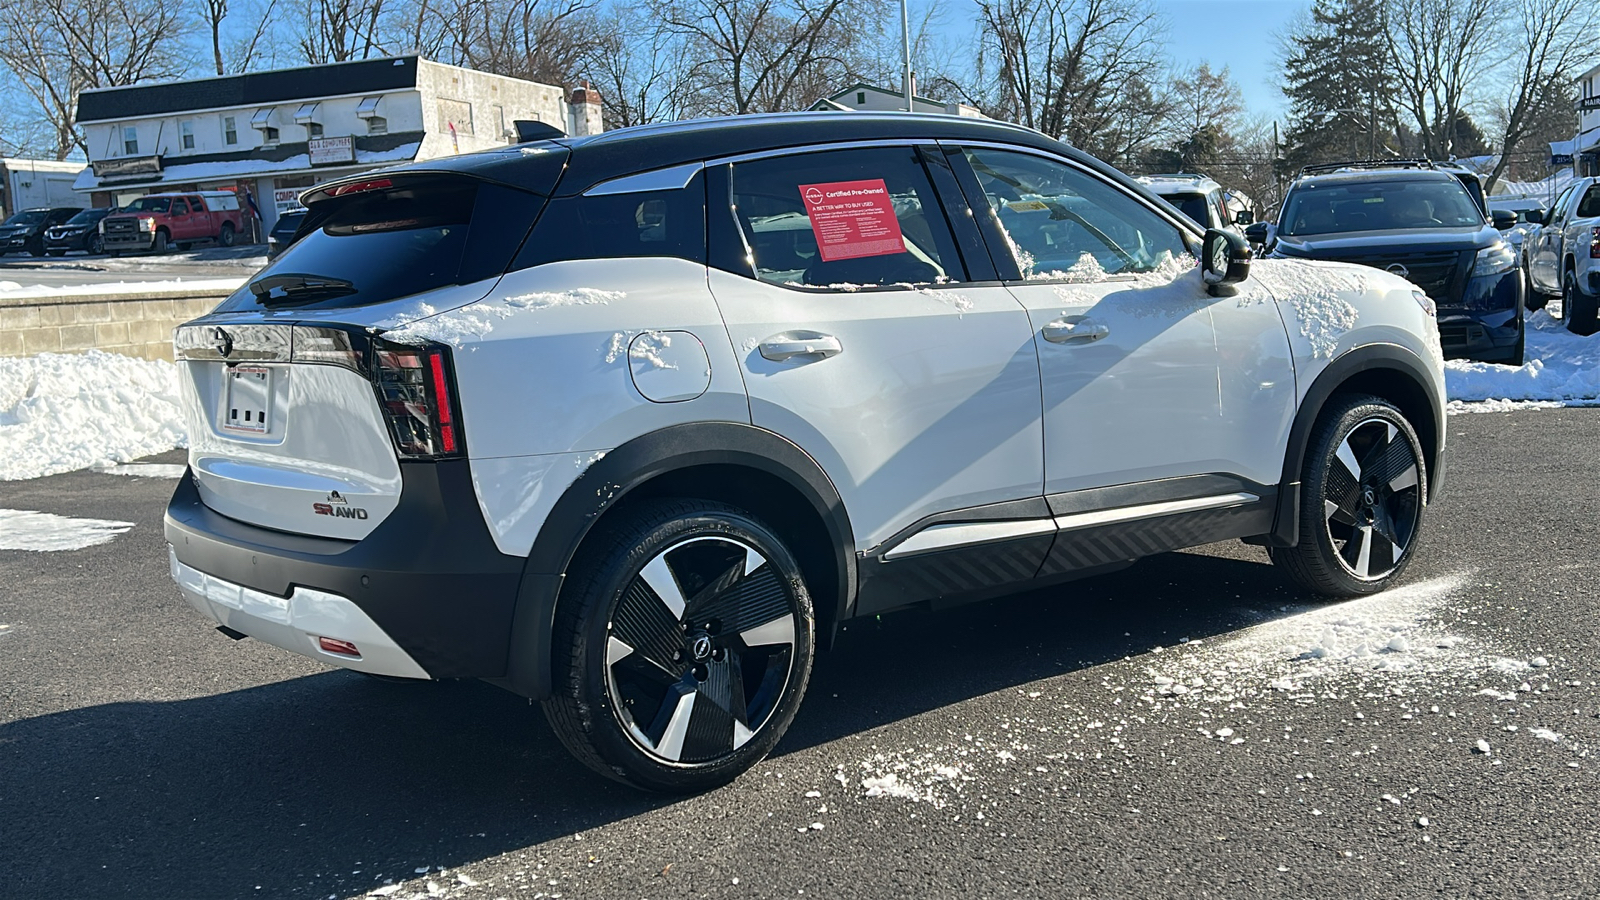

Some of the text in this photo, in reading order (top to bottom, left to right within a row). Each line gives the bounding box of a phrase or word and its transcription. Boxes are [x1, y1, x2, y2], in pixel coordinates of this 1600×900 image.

[826, 188, 884, 198] Certified Pre-Owned
[313, 502, 368, 520] SR AWD
